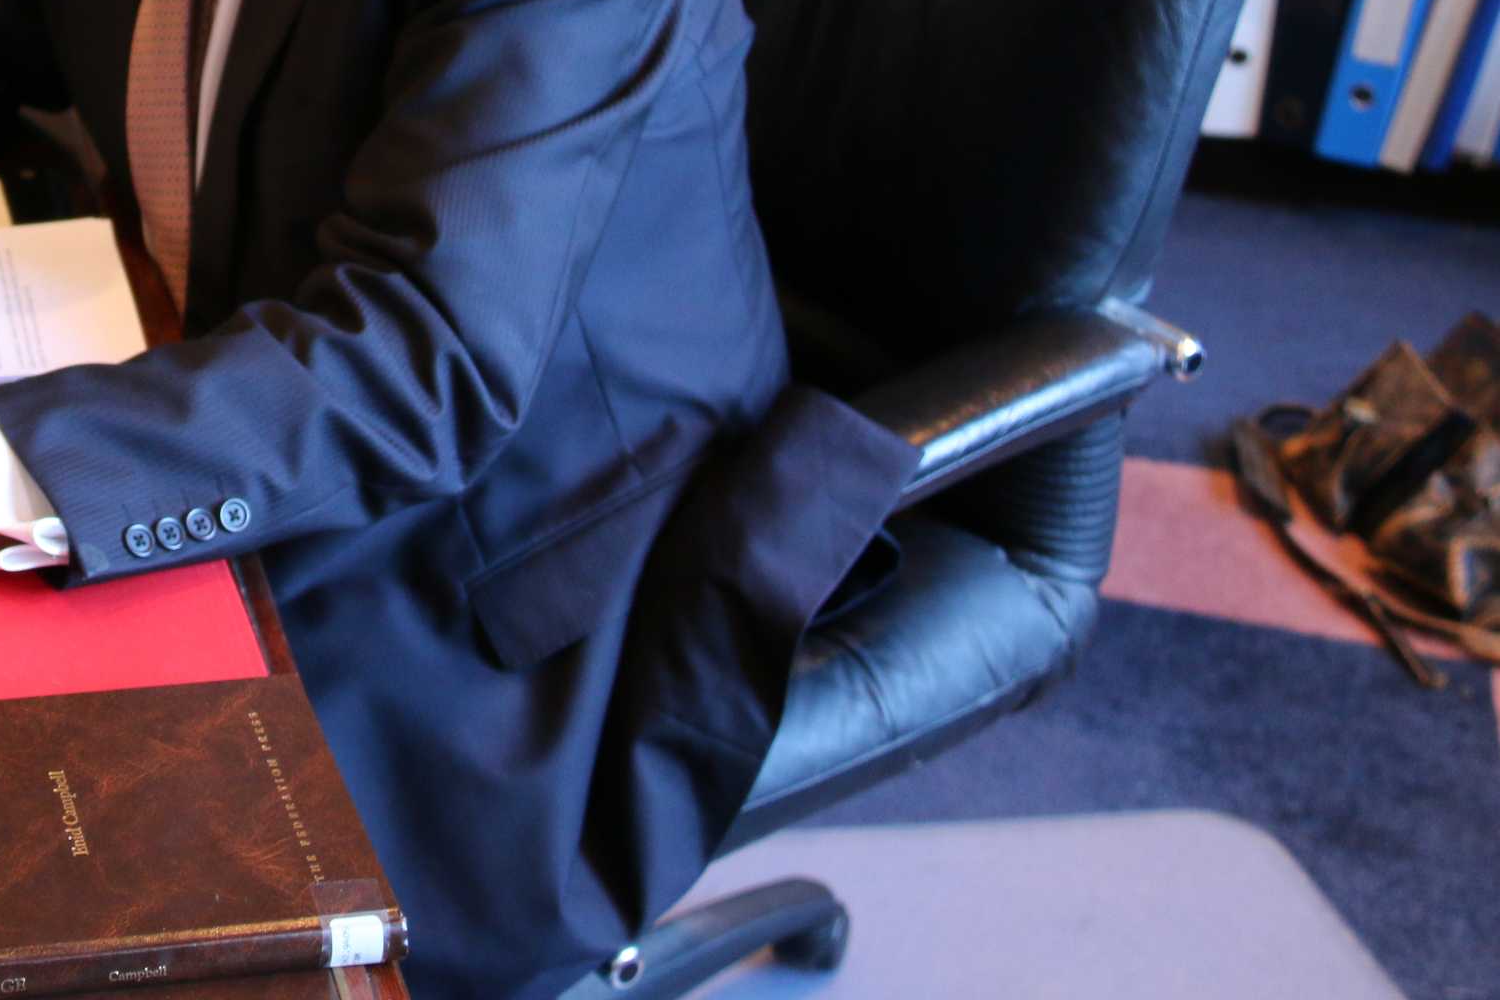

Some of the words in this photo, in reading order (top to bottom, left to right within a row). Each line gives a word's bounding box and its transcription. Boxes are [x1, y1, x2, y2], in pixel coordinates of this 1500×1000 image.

[248, 711, 272, 752] PRESS
[48, 770, 79, 825] Campbell
[266, 759, 311, 847] FEDERATION
[64, 826, 89, 857] Enid
[306, 854, 325, 884] THE
[108, 964, 167, 982] Campbell
